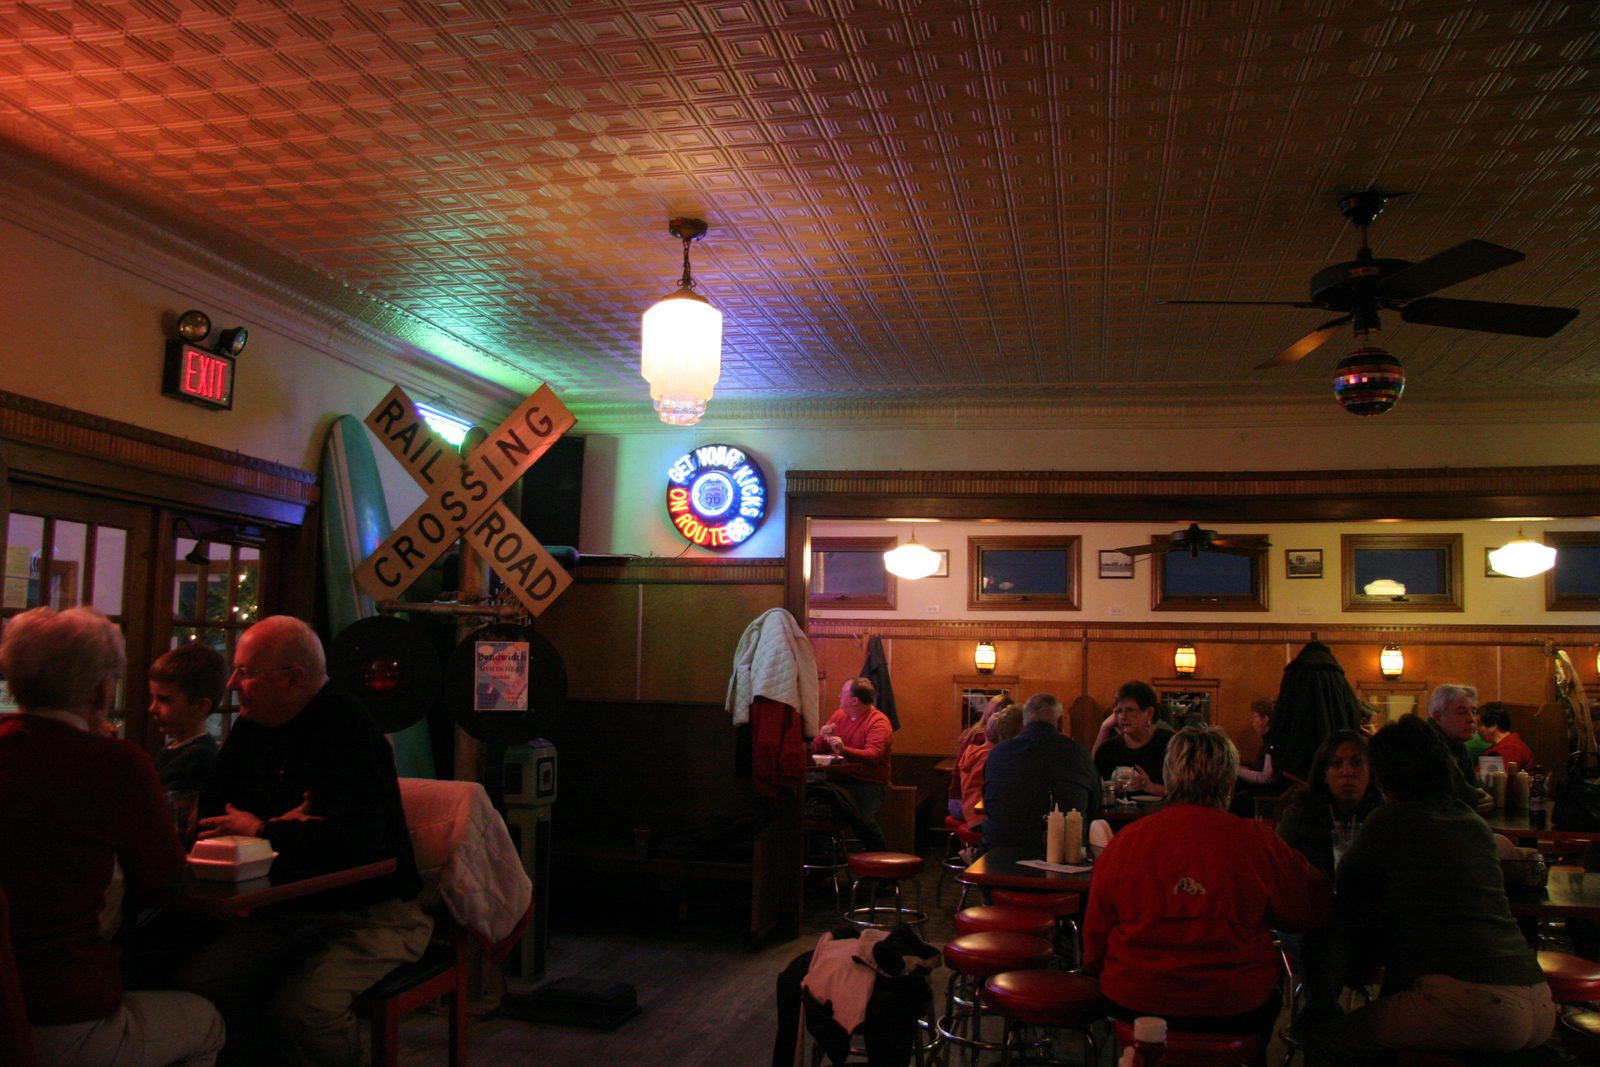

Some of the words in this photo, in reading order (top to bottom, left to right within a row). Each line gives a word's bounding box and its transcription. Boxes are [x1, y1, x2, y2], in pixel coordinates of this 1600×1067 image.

[185, 350, 229, 400] EXIT
[373, 406, 554, 588] CROSSING
[374, 398, 443, 486] RAIL
[473, 510, 557, 602] ROAD
[668, 454, 695, 483] GET
[696, 446, 744, 470] YOUR
[733, 465, 762, 518] KICKS
[670, 488, 688, 512] ON
[675, 513, 731, 546] ROUTE
[726, 517, 752, 543] 66
